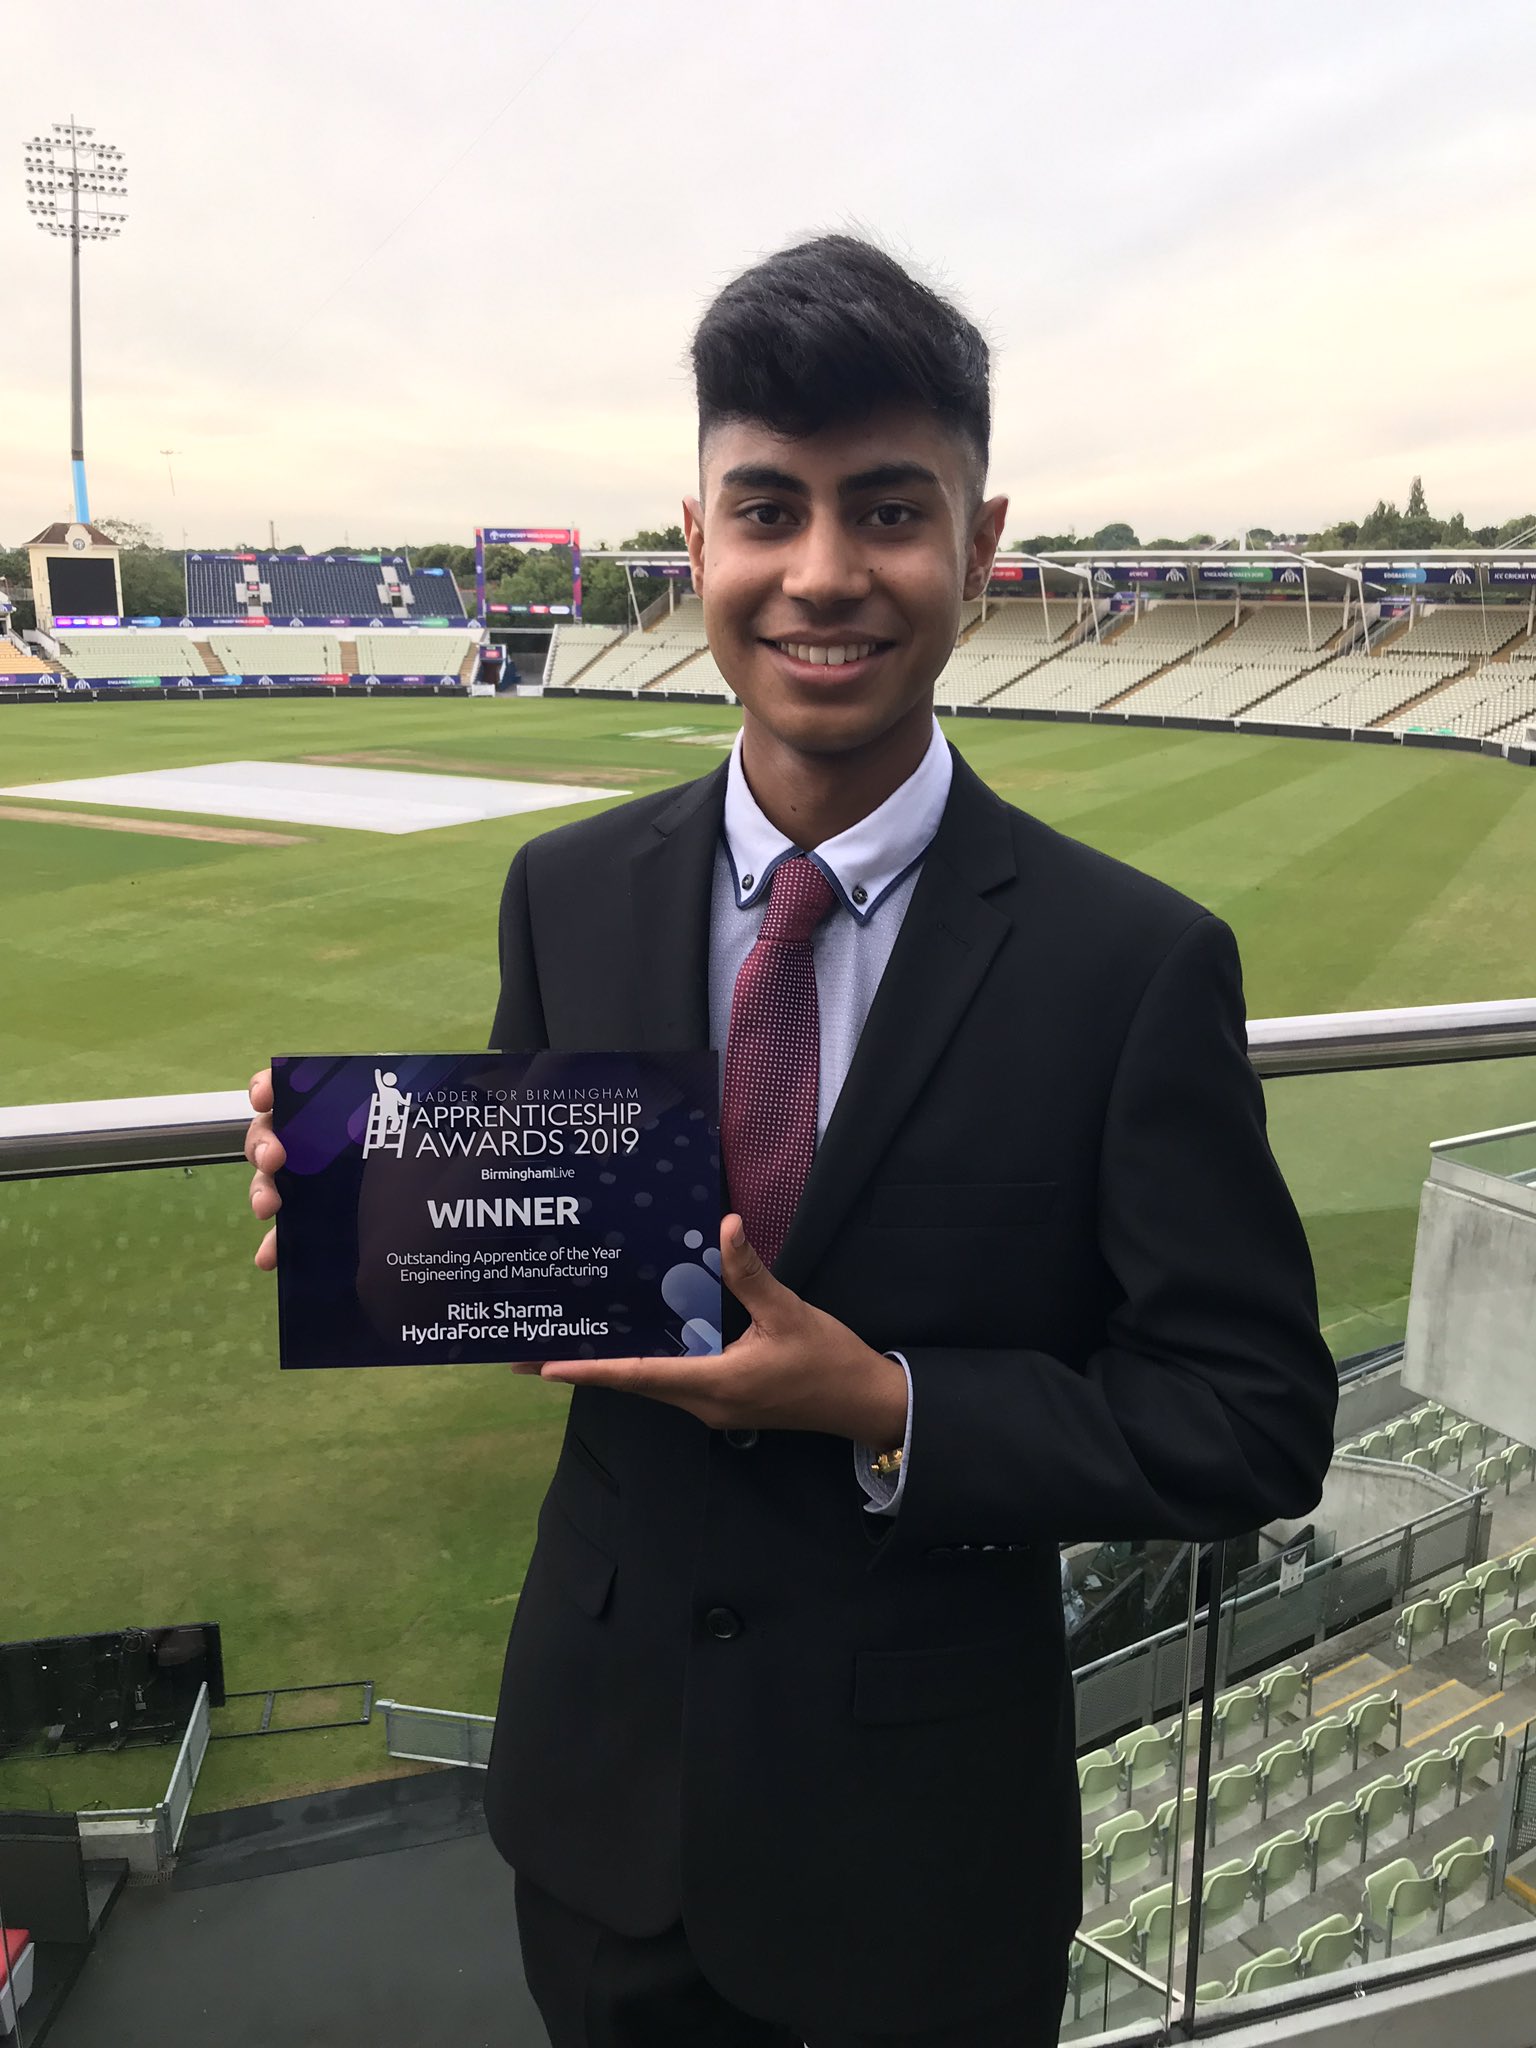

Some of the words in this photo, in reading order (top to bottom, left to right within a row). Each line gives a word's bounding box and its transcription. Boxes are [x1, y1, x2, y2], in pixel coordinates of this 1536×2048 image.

[417, 1090, 478, 1103] LADDER
[486, 1089, 518, 1101] FOR
[526, 1087, 639, 1101] BIRMINGHAM
[411, 1102, 642, 1129] APPRENTICESHIP
[415, 1130, 564, 1158] AWARDS
[573, 1128, 640, 1155] 2019
[480, 1167, 576, 1182] BirminghamLive
[426, 1196, 581, 1230] WINNER
[386, 1251, 471, 1267] Outstanding
[473, 1248, 547, 1264] Apprentice
[550, 1248, 566, 1260] of
[567, 1247, 589, 1260] the
[591, 1245, 622, 1260] Year
[399, 1267, 480, 1284] Engineering
[483, 1265, 509, 1279] and
[511, 1263, 609, 1280] Manufacturing
[447, 1302, 490, 1321] Ritik
[494, 1302, 563, 1319] Sharma
[401, 1322, 509, 1345] HydraForce
[513, 1319, 609, 1338] Hydraulics
